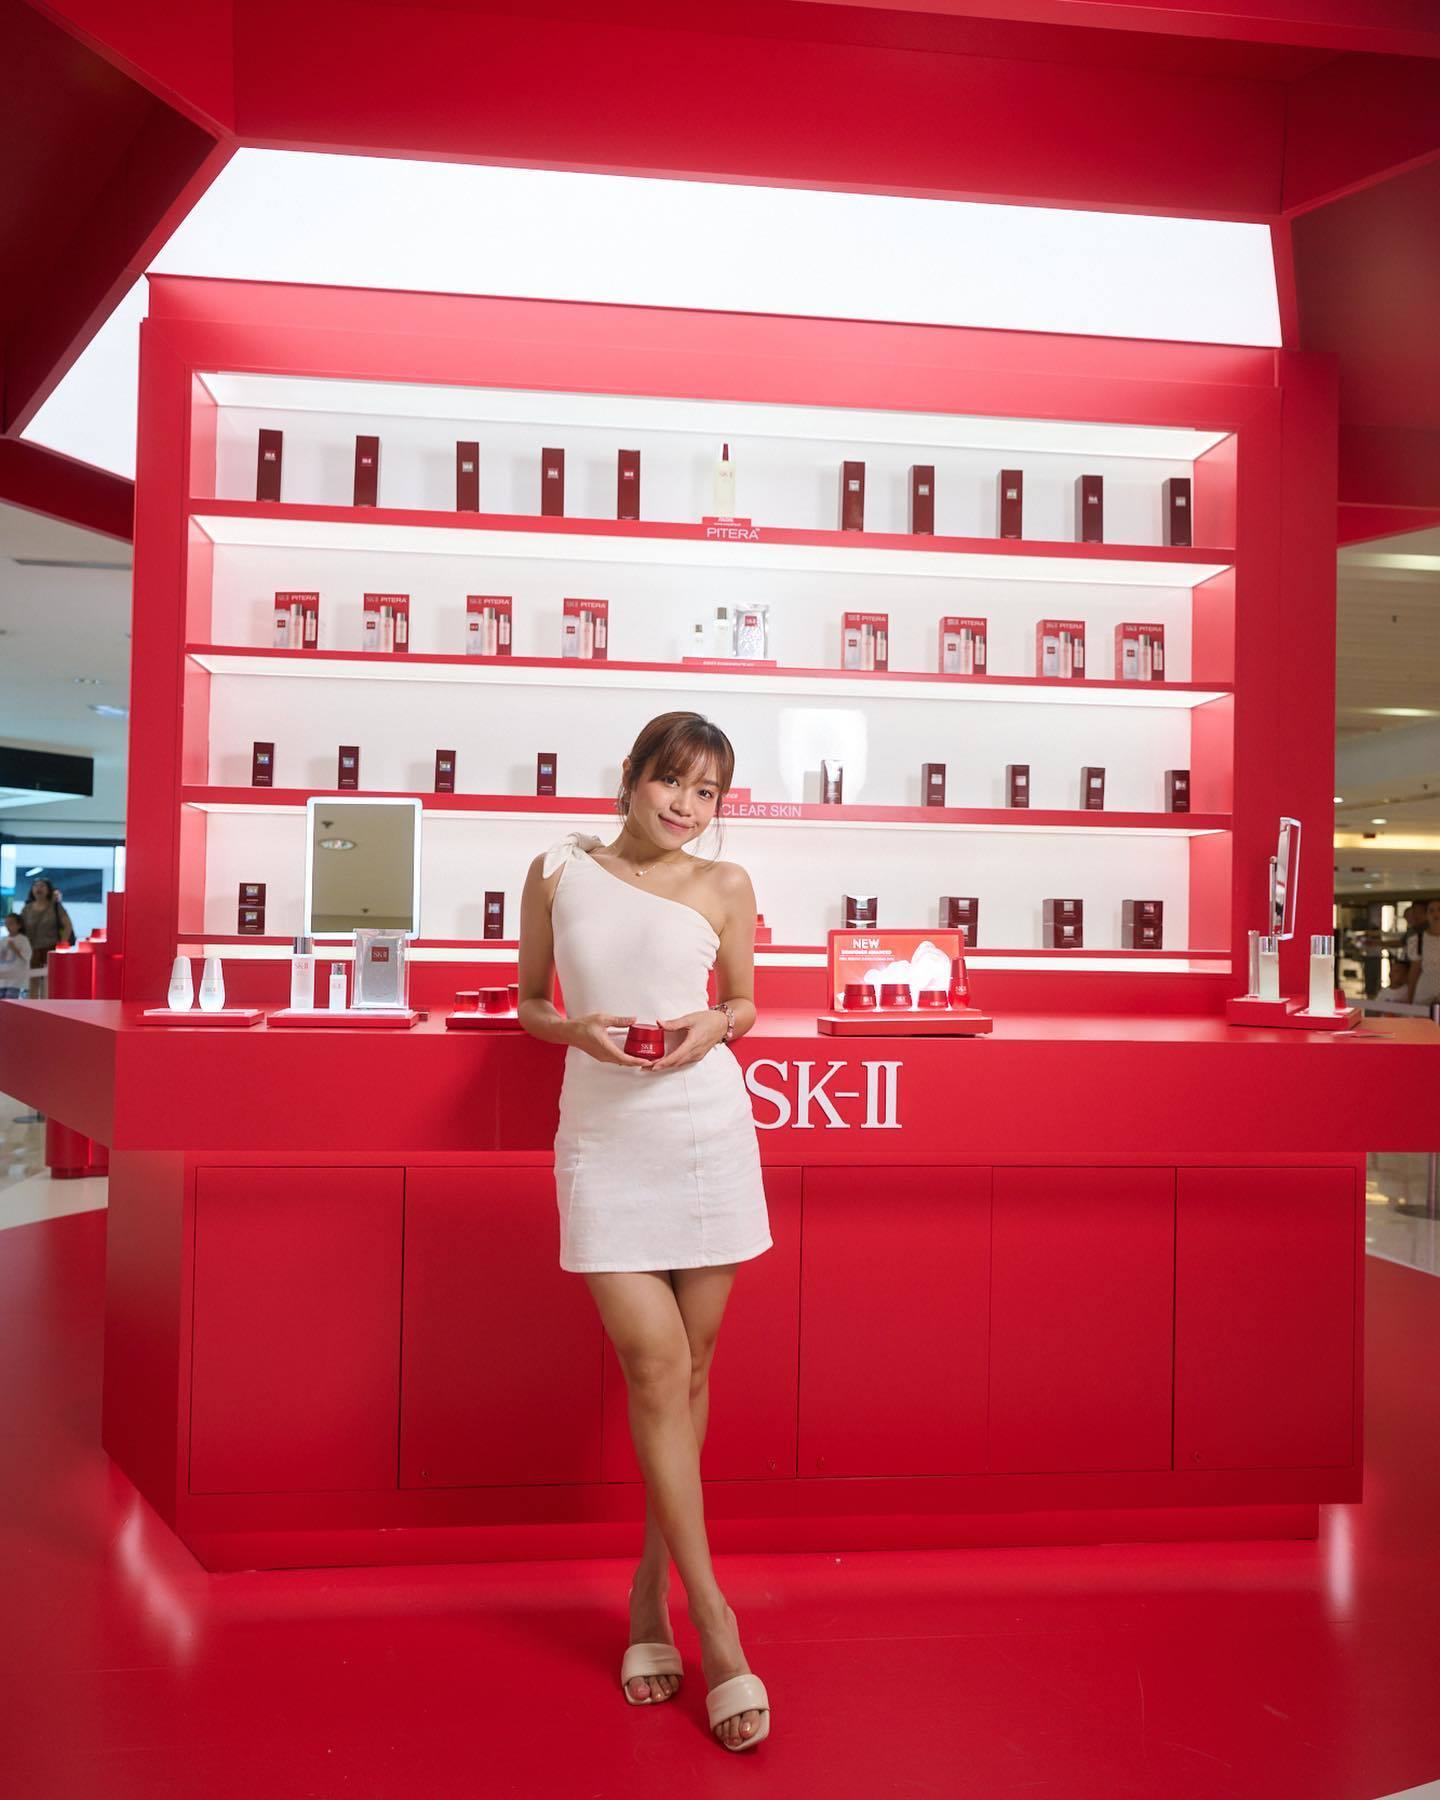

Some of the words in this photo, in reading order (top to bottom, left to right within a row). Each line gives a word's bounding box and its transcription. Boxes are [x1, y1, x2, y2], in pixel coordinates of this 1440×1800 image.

[380, 596, 407, 604] PITERA
[580, 601, 606, 609] PITERA
[721, 803, 767, 817] CLEAR
[769, 804, 802, 817] SKIN
[852, 938, 880, 949] NEW
[744, 1058, 904, 1130] SK-II
